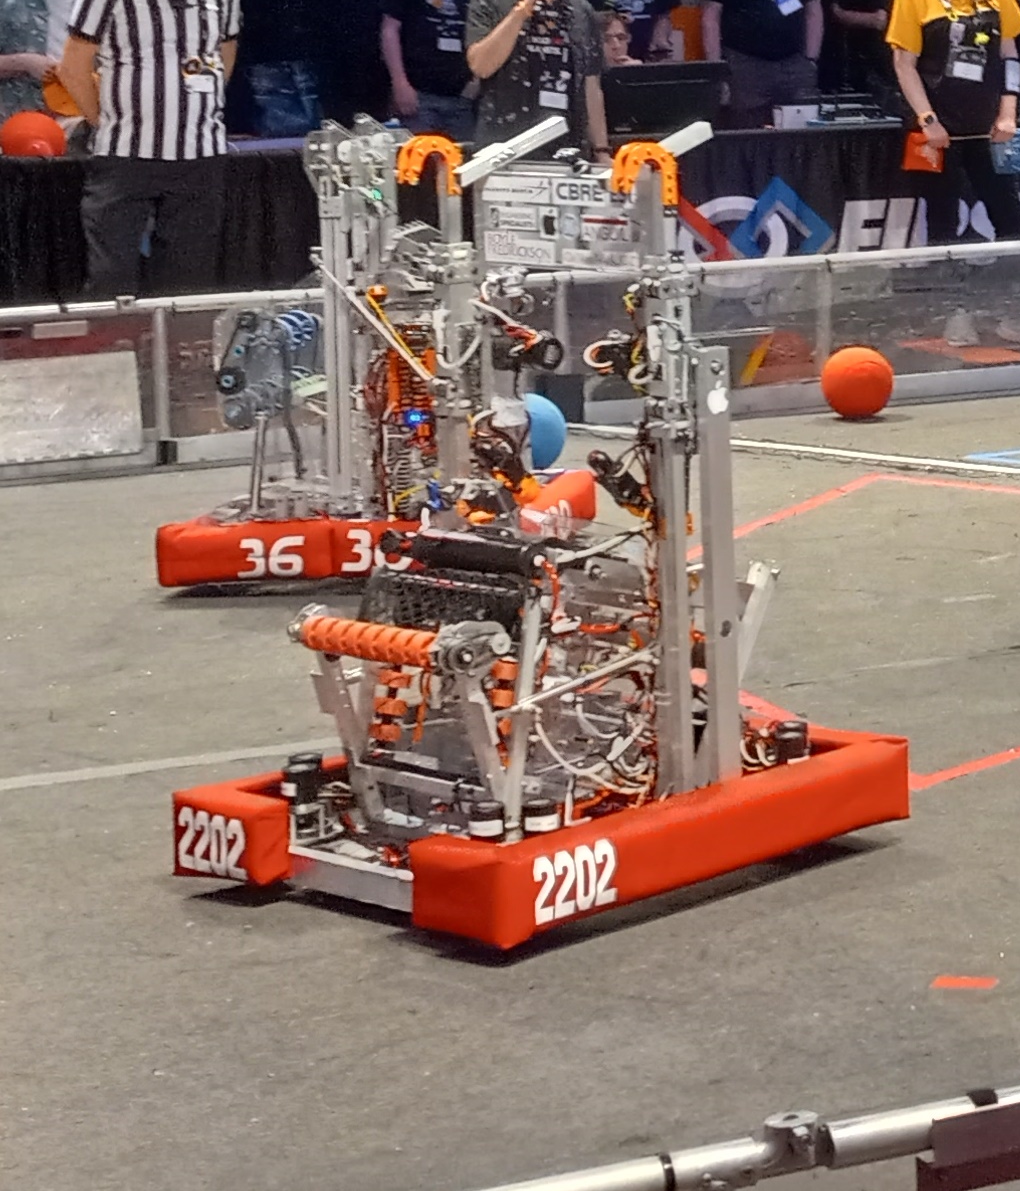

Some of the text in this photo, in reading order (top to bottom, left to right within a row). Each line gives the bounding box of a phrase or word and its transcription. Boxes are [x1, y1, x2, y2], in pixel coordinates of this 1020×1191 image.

[556, 182, 603, 202] CBRE
[236, 535, 306, 579] 36
[177, 806, 247, 881] 2202
[533, 838, 618, 926] 2202
